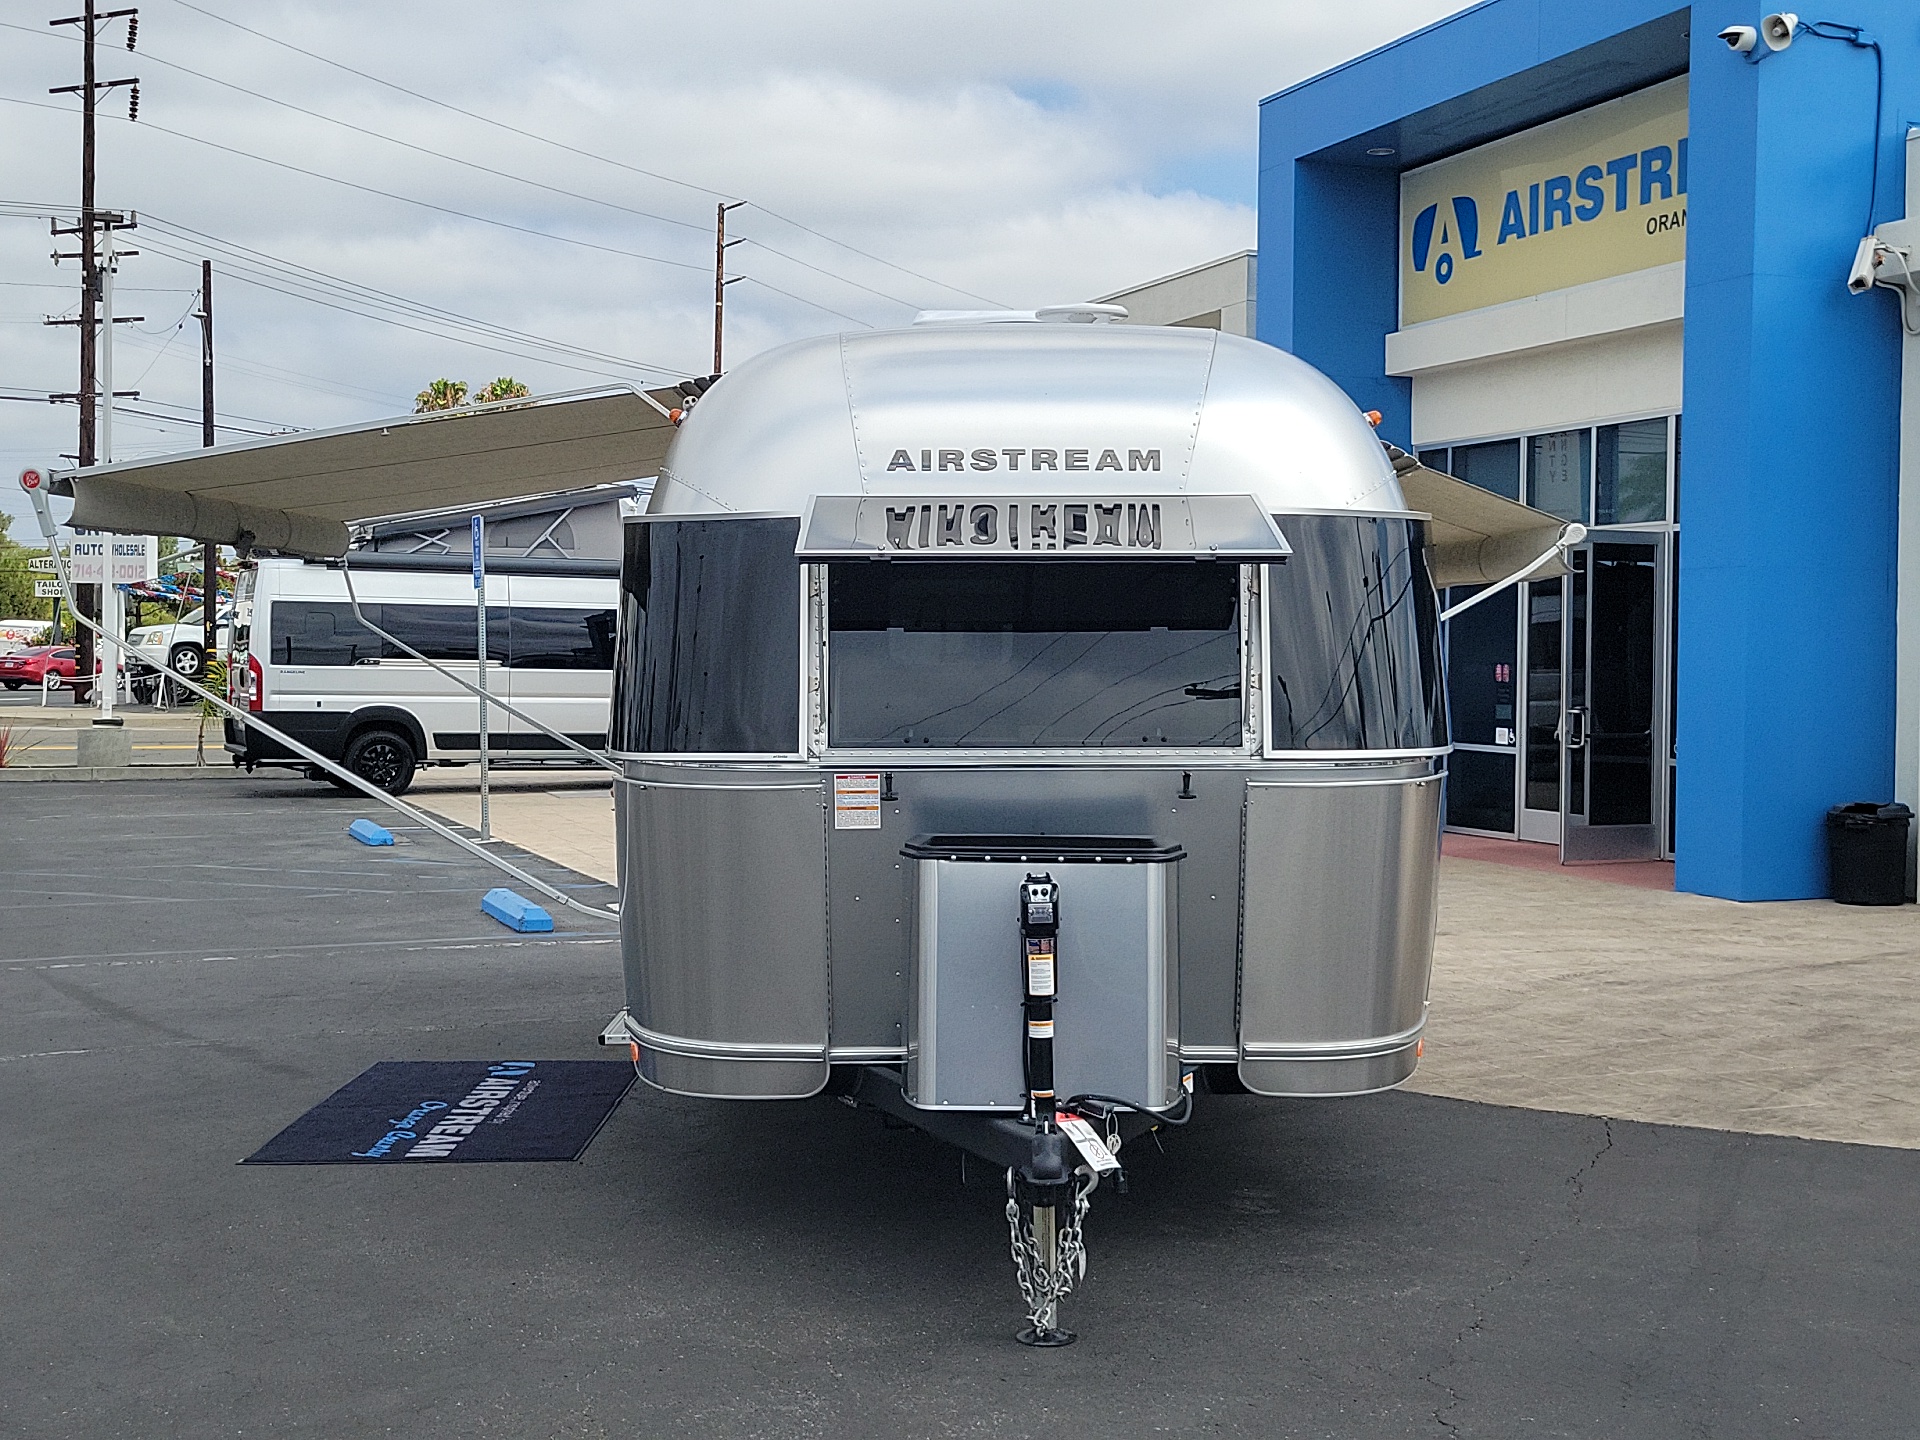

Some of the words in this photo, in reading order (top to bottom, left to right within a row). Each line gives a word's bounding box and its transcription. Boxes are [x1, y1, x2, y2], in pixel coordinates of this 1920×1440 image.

[886, 448, 1162, 472] AIRSTREAM
[112, 543, 146, 556] HOLESALE
[29, 559, 71, 569] ALTERIO
[388, 1101, 449, 1129] Orange
[404, 1077, 520, 1158] AIRSTREAM
[351, 1130, 417, 1158] County
